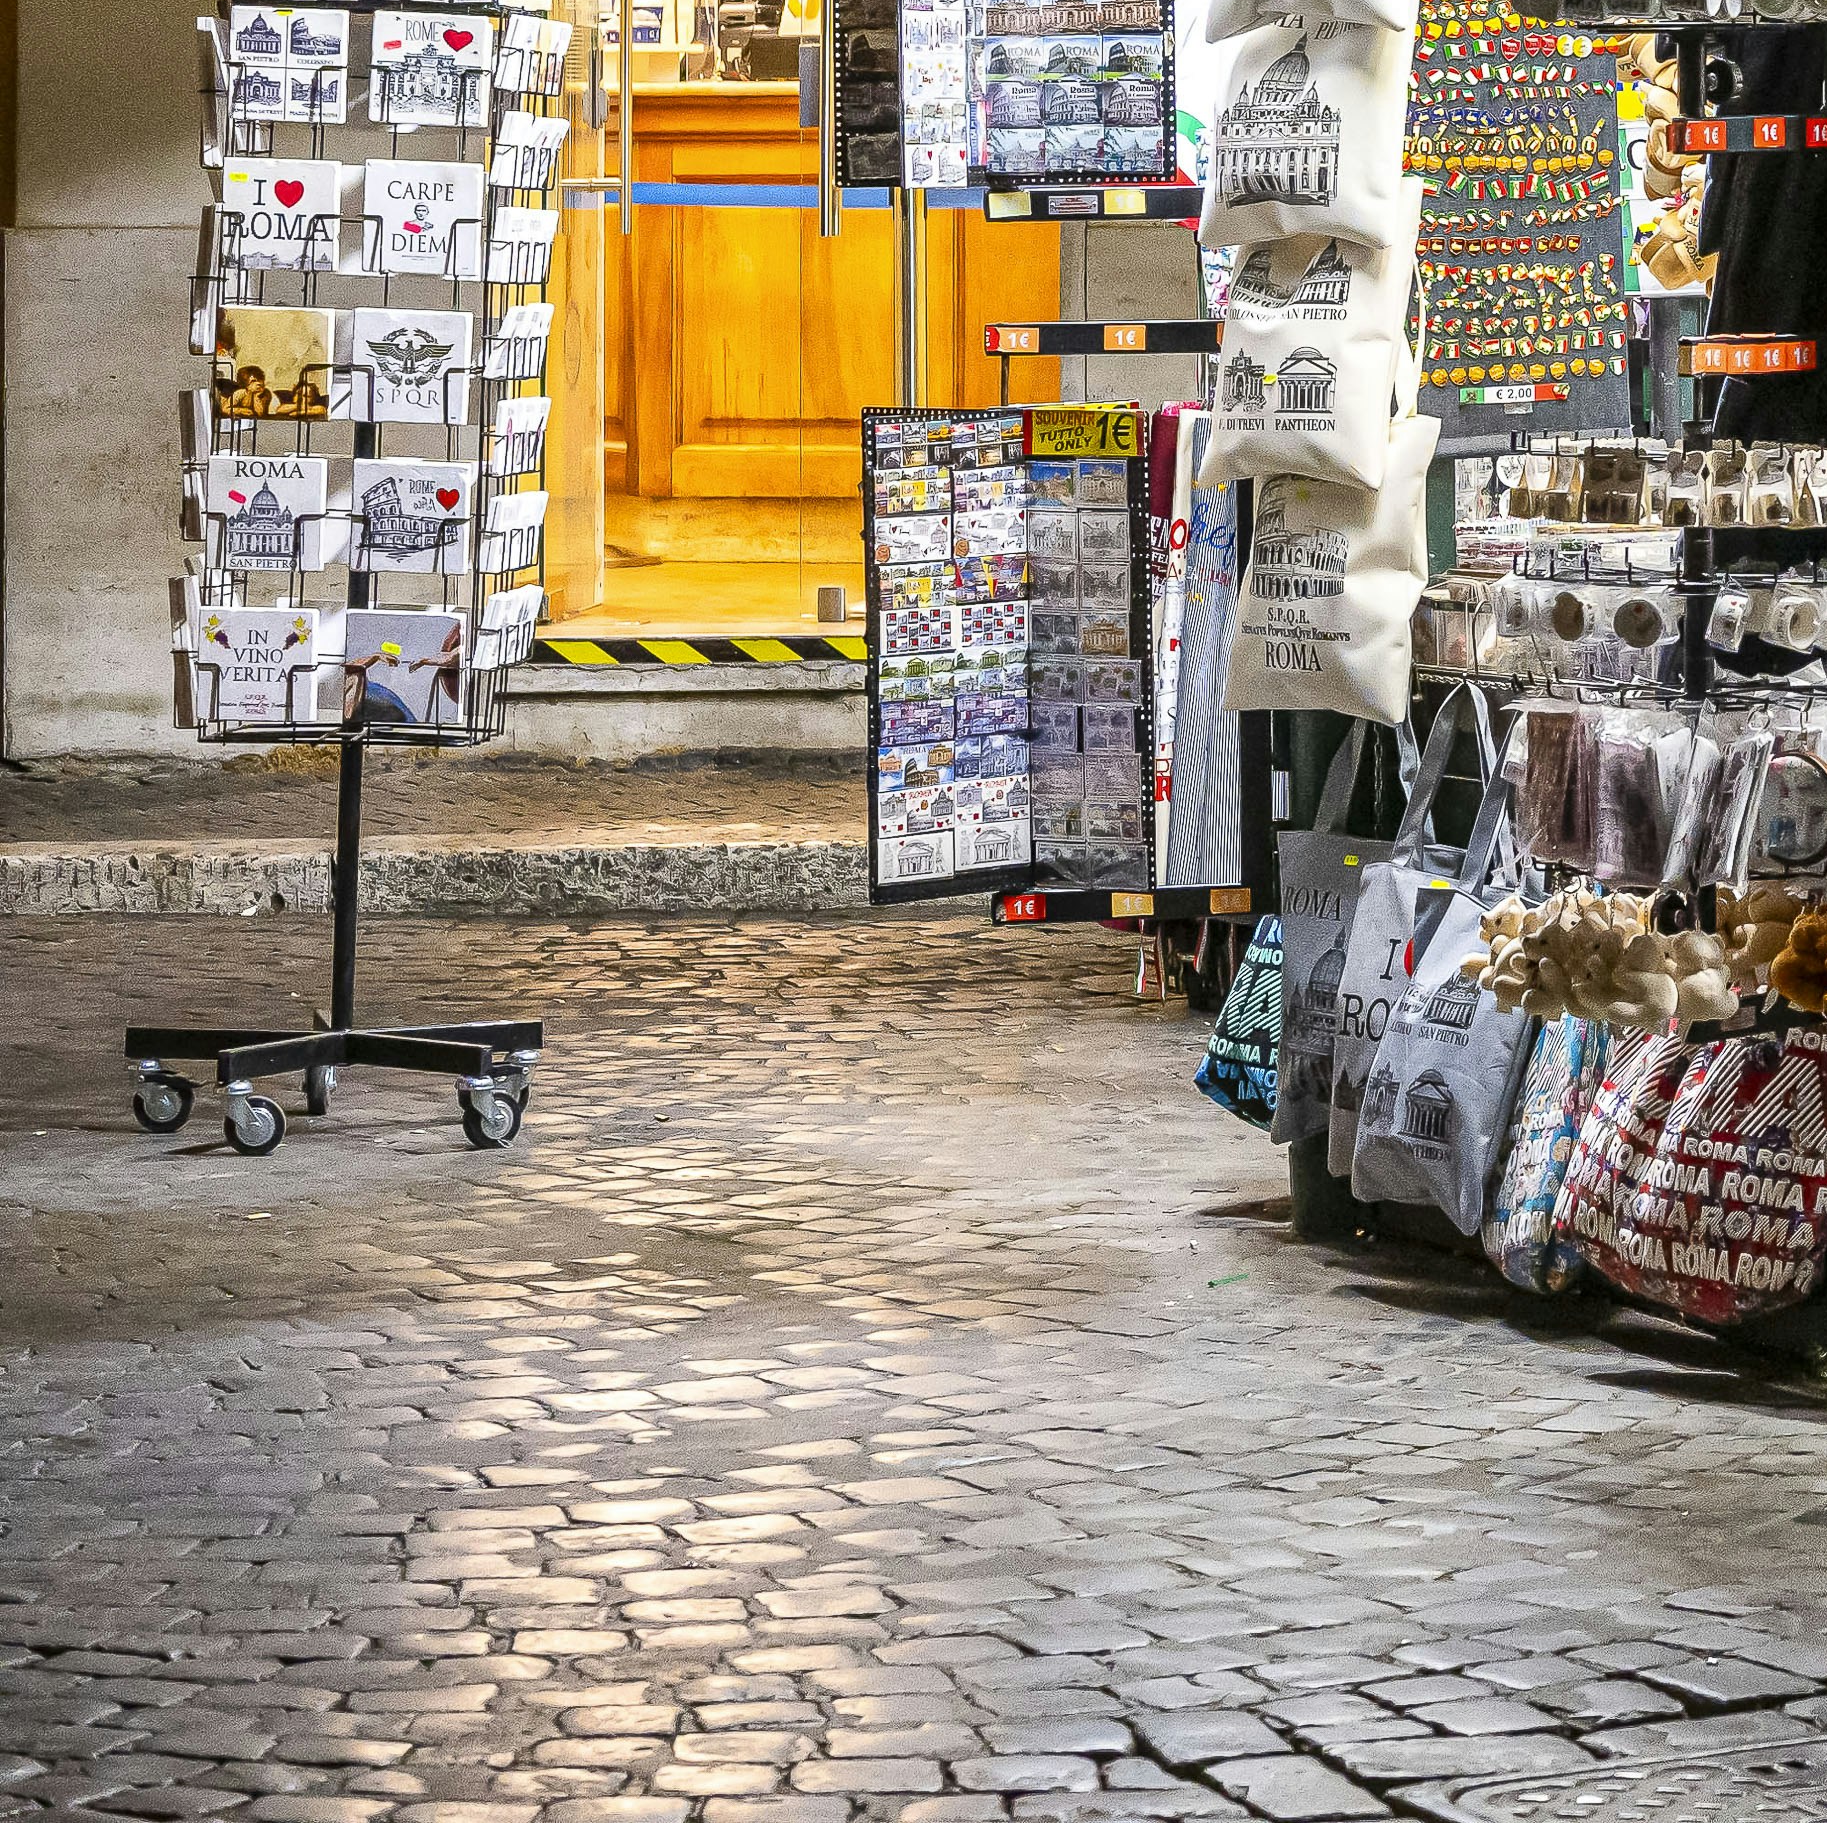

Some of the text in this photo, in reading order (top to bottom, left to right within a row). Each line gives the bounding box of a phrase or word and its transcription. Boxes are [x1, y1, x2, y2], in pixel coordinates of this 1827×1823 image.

[405, 20, 438, 42] ROME
[1127, 44, 1160, 55] ROMA
[1702, 126, 1721, 143] 1€
[1761, 122, 1779, 141] 1€
[253, 179, 267, 205] I
[388, 181, 454, 202] CARPE
[224, 212, 330, 241] ROMA
[391, 233, 449, 253] DIEM
[1303, 309, 1347, 321] PIETRO
[1007, 330, 1030, 350] 1€
[1115, 330, 1136, 348] 1€
[1704, 347, 1722, 366] 1€
[1734, 347, 1752, 366] 1€
[1764, 347, 1781, 366] 1€
[1793, 346, 1810, 365] 1€
[1507, 387, 1532, 400] 2,00
[1035, 411, 1133, 451] SOUVENIR 1€
[1238, 419, 1265, 432] TREVI
[1275, 418, 1335, 432] PANTHEON
[1038, 428, 1084, 444] TUTTO
[1053, 437, 1092, 454] ONLY
[235, 460, 305, 479] ROMA
[409, 479, 435, 495] ROME
[1267, 607, 1310, 624] S.P.Q.R.
[248, 629, 268, 645] IN
[234, 648, 284, 664] VINO
[1264, 642, 1322, 672] ROMA
[219, 666, 299, 684] VERITAS
[1012, 897, 1036, 917] 1€
[1283, 886, 1341, 921] ROMA
[1380, 939, 1401, 980] I
[1341, 993, 1391, 1041] RO
[1419, 1026, 1470, 1047] SAN PIETRO
[1684, 1137, 1827, 1177] ROMA ROMA
[1722, 1171, 1804, 1212] ROMA
